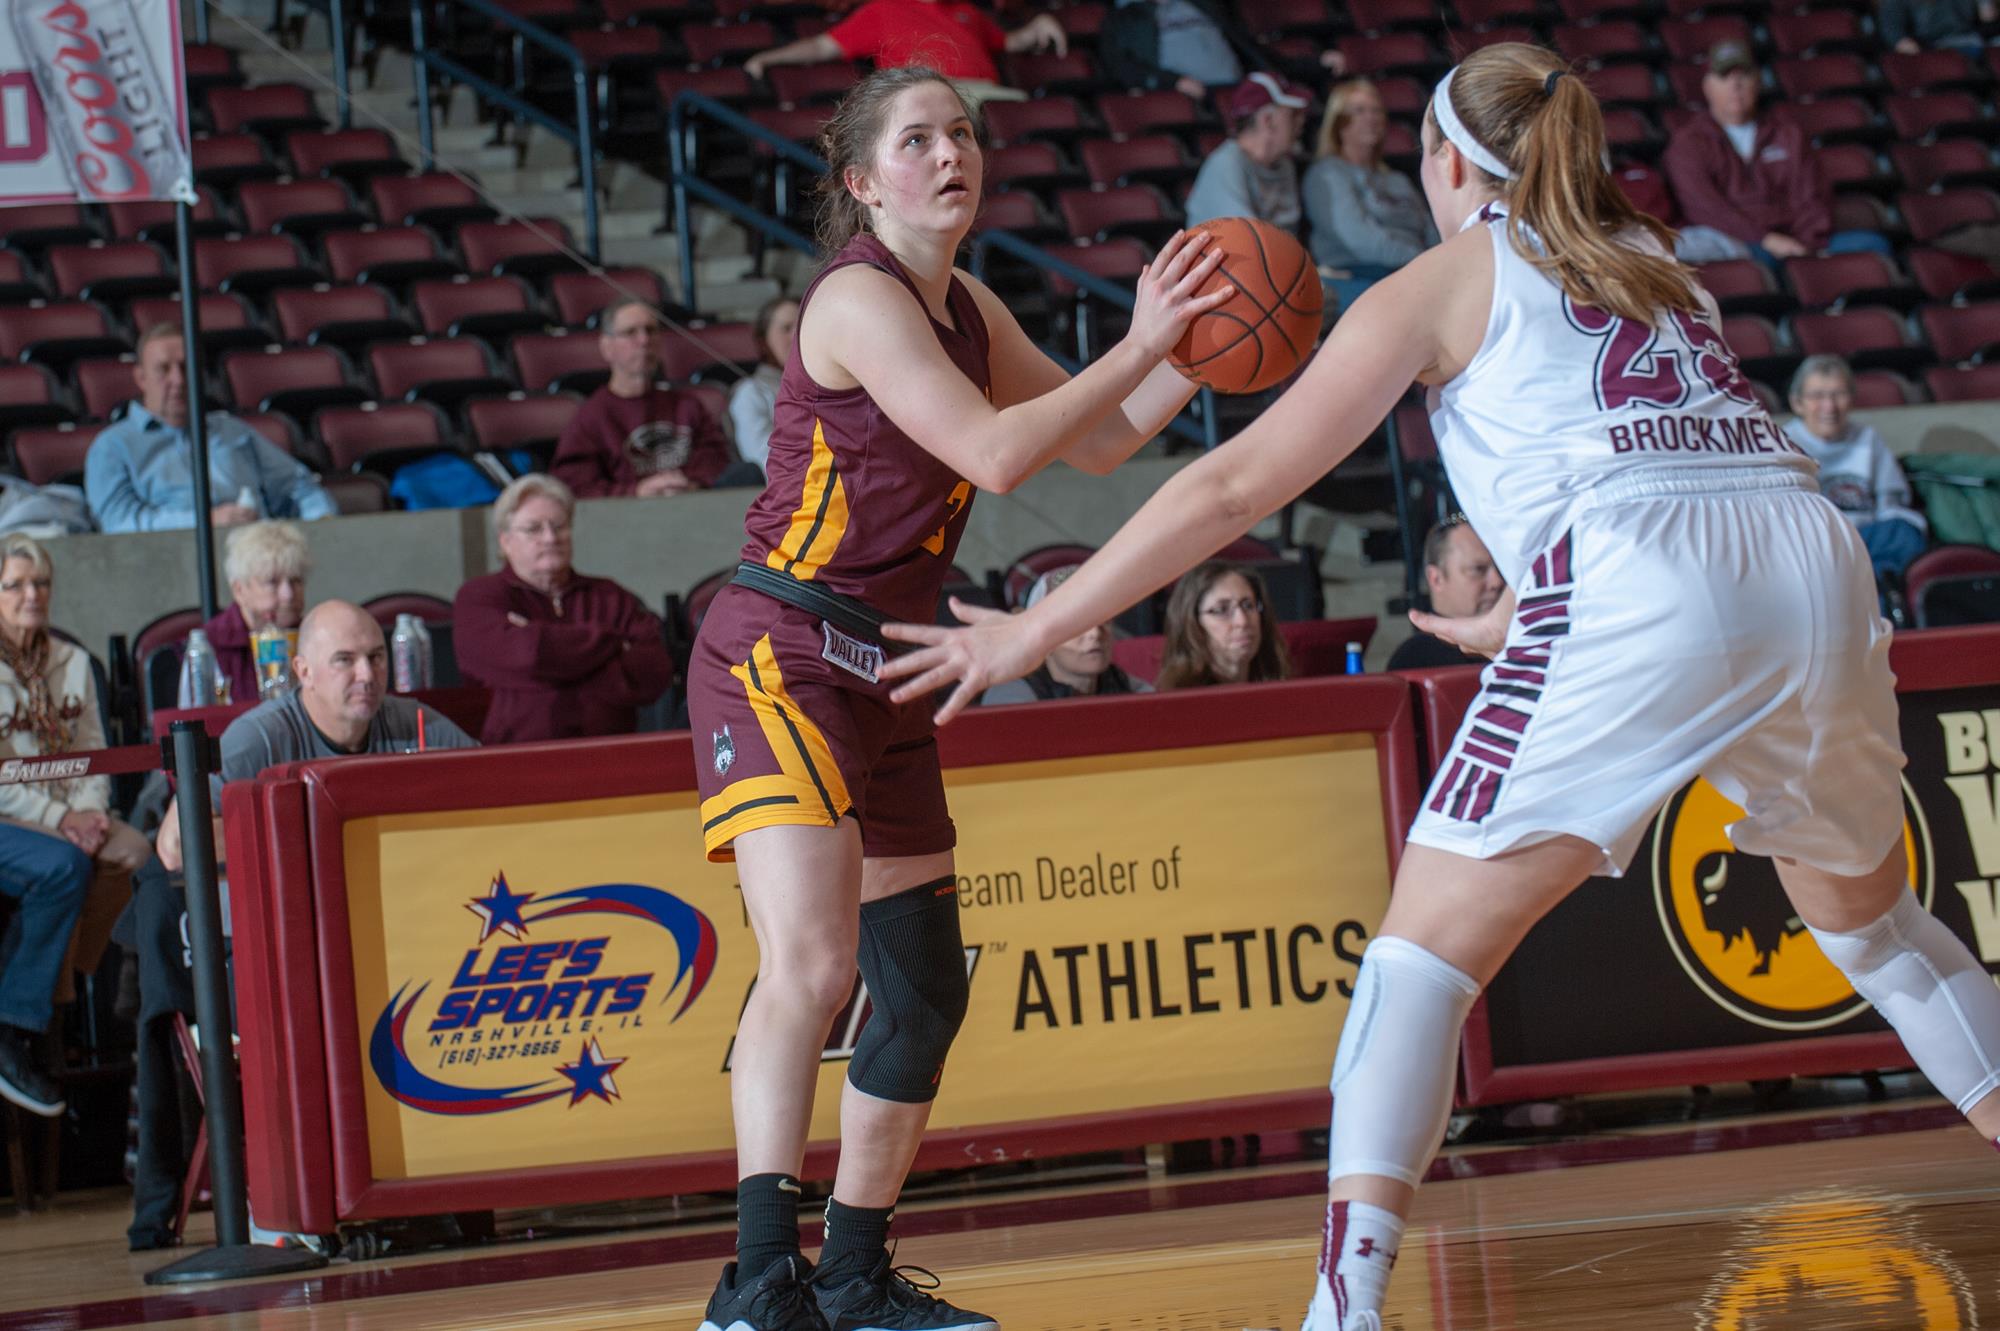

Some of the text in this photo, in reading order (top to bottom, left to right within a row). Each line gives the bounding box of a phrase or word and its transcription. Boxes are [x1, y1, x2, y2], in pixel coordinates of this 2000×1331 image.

[97, 27, 167, 158] LIGHT
[1609, 415, 1806, 454] BROCKMEY
[829, 632, 878, 674] VALLEY
[957, 845, 1182, 909] eam Dealer of
[450, 936, 612, 989] LEE'S
[1013, 919, 1367, 1032] ATHLETICS
[427, 972, 655, 1032] SPORTS
[619, 1013, 644, 1029] IL
